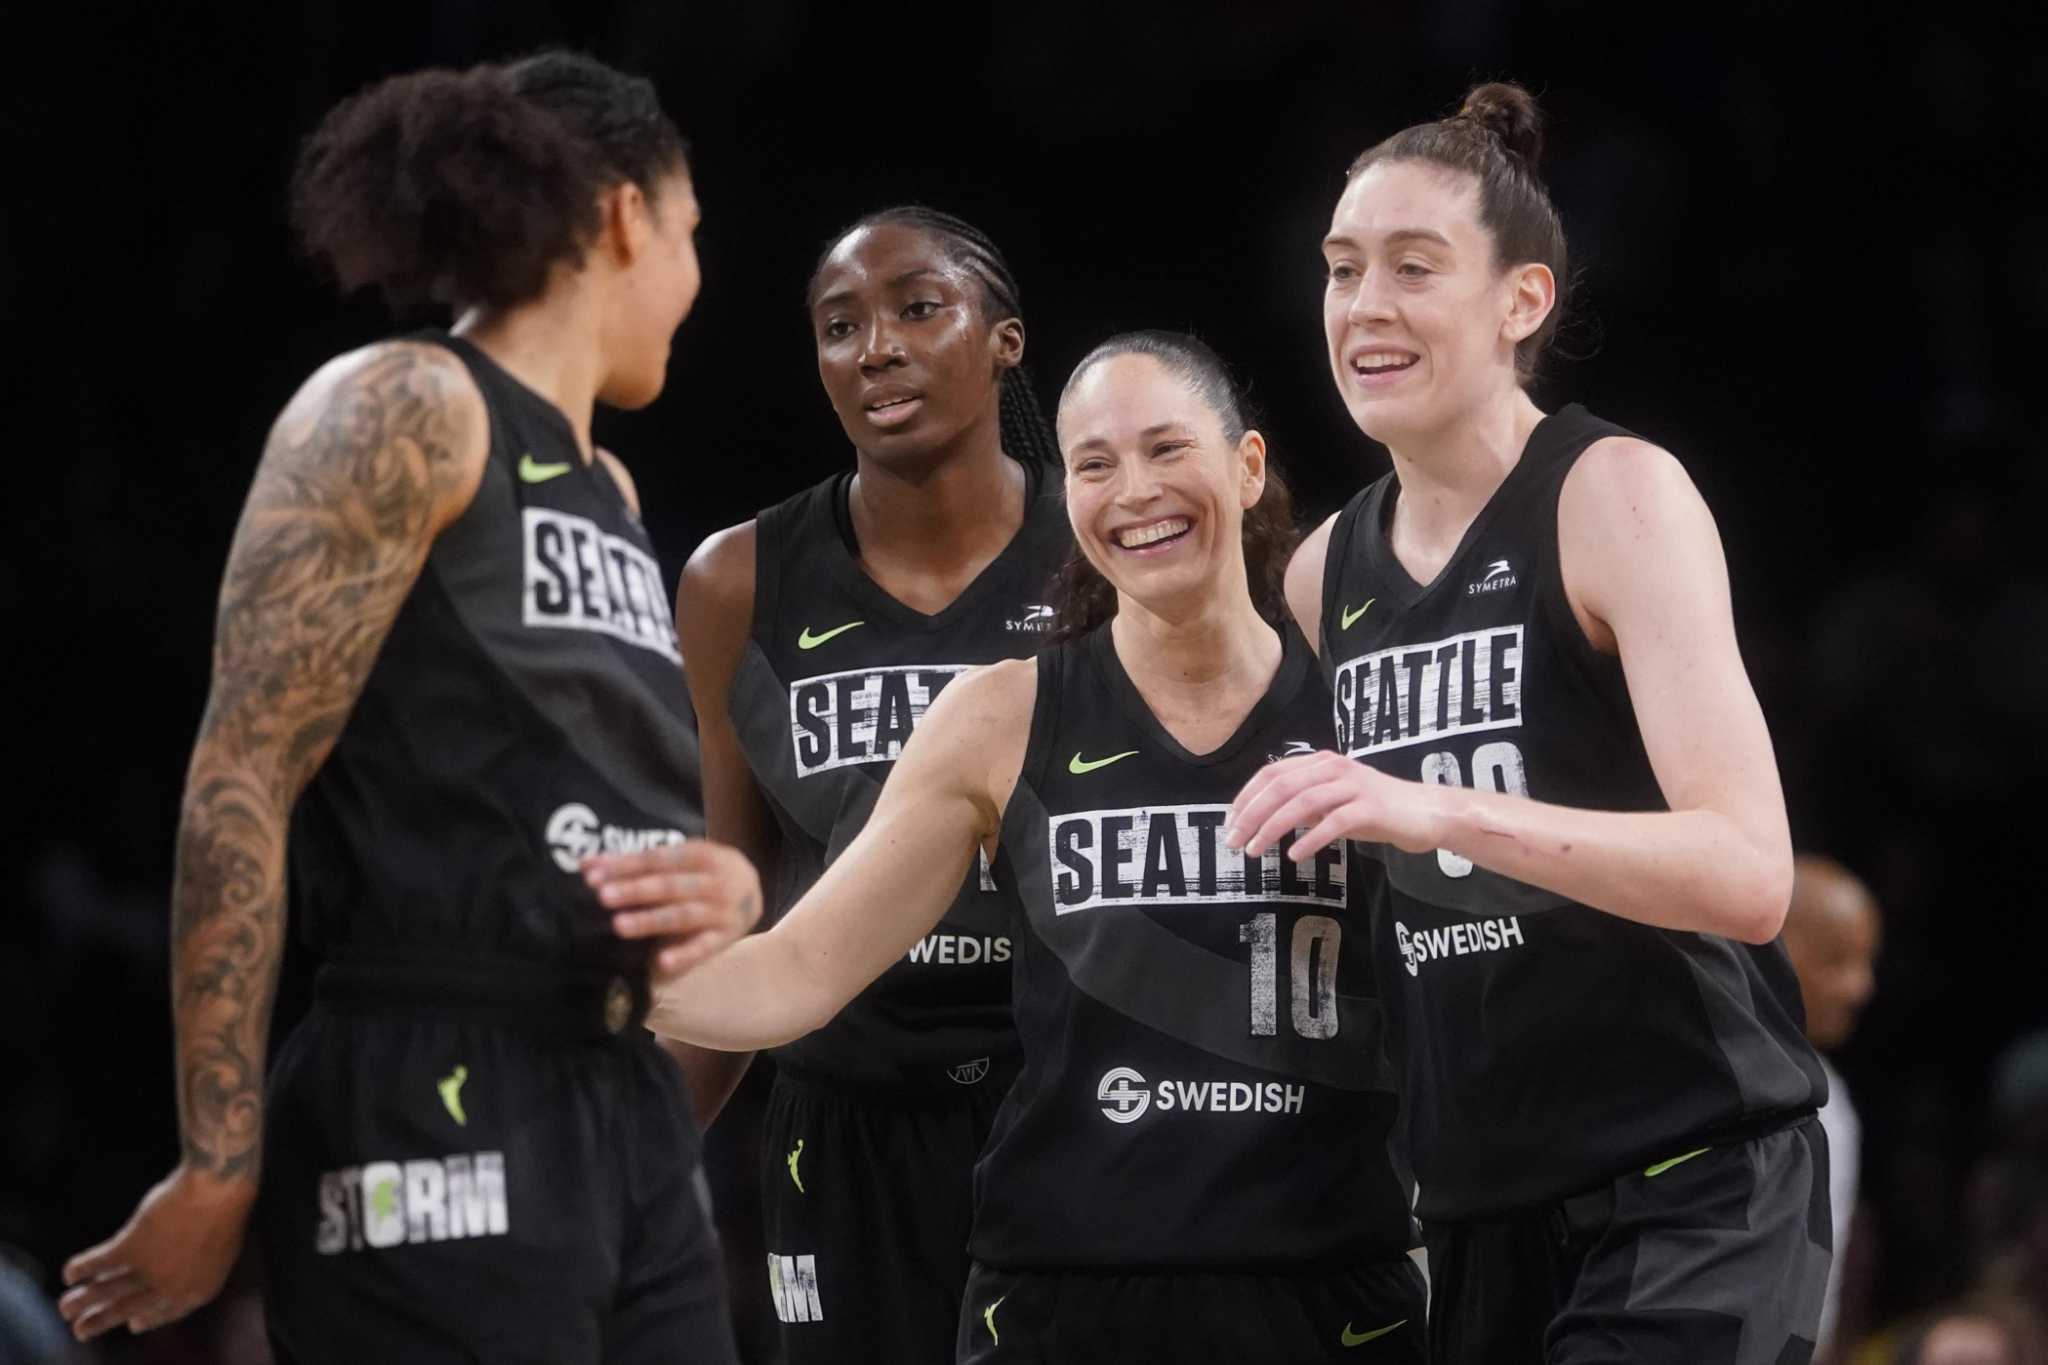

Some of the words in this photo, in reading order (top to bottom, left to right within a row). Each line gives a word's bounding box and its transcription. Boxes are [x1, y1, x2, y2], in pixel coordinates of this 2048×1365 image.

[1468, 576, 1517, 594] SYMETRA
[1336, 632, 1518, 757] SEATTLE
[908, 935, 1012, 965] WEDIS
[1412, 915, 1525, 963] SWEDISH
[1239, 912, 1342, 1040] 10
[1156, 1080, 1305, 1114] SWEDISH
[316, 1151, 509, 1254] STORM
